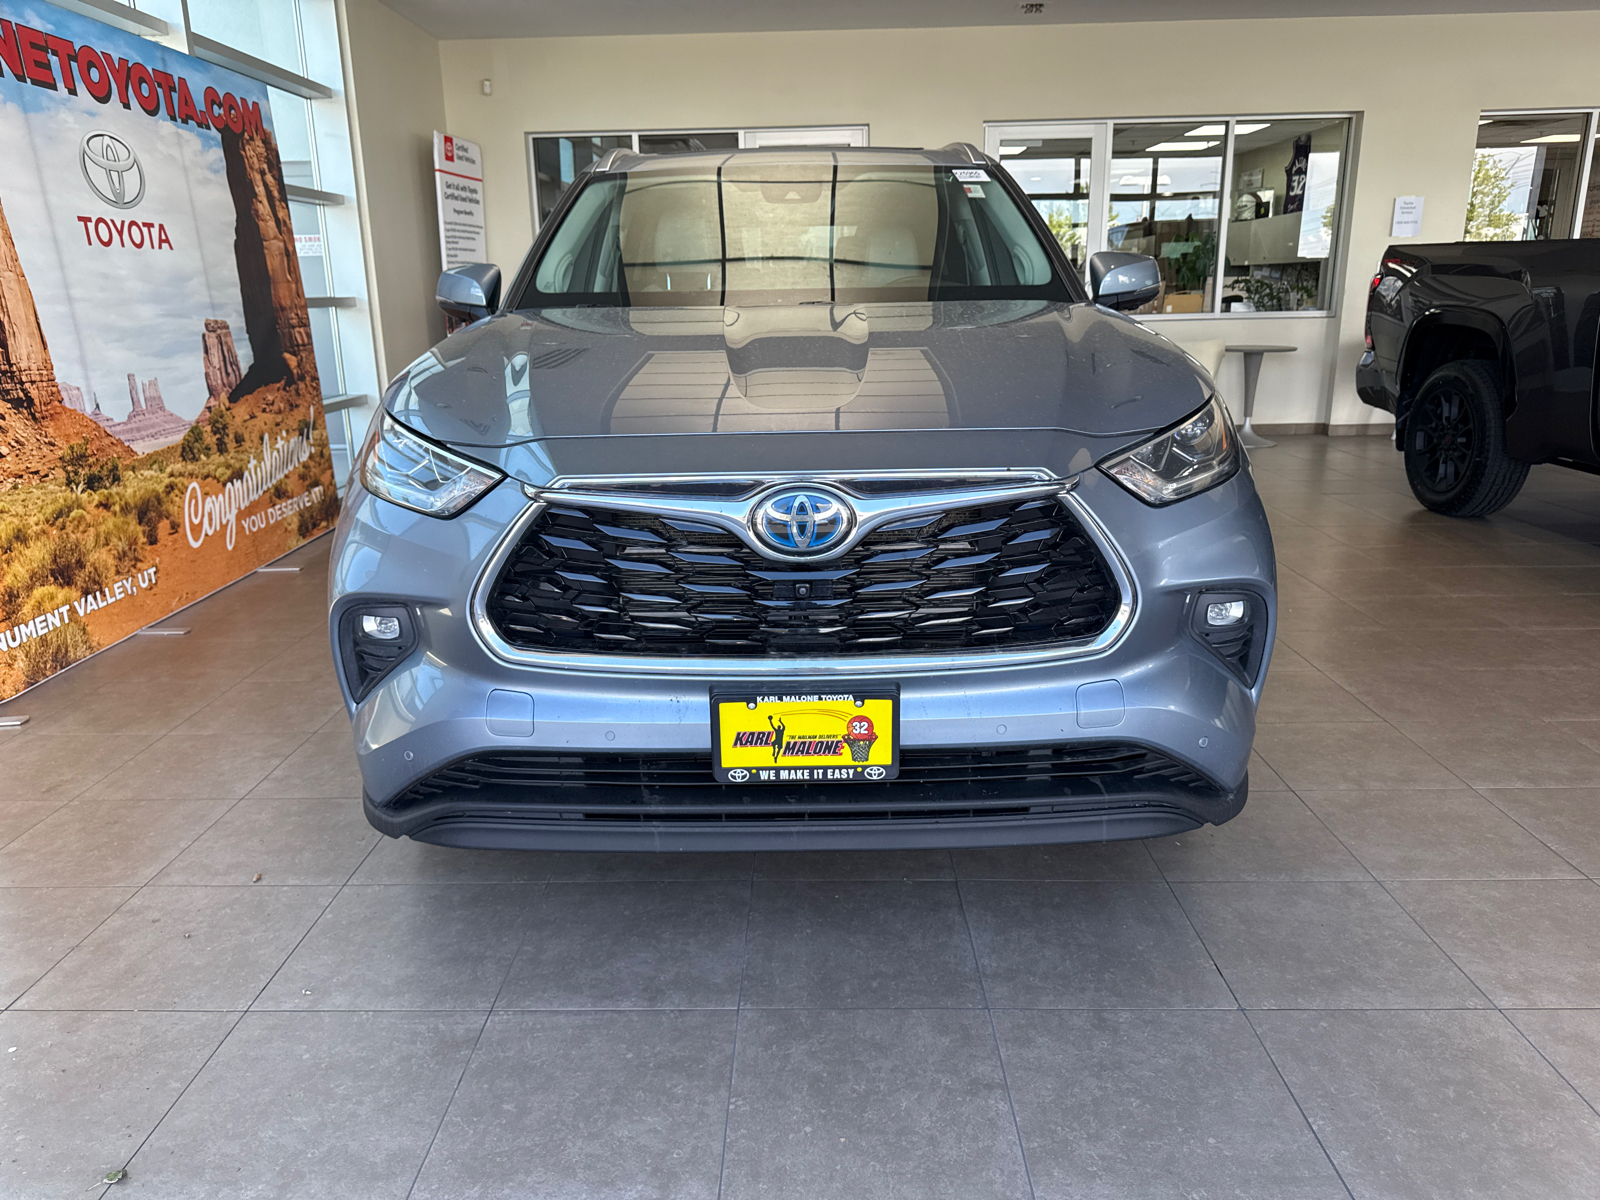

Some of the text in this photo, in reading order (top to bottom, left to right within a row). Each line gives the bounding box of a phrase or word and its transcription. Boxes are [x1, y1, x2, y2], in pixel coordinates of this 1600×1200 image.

[1289, 175, 1306, 196] 32
[76, 215, 174, 251] TOYOTA
[184, 404, 316, 551] Congratulations!
[241, 485, 325, 535] YOU DESERVE IT!
[73, 576, 137, 618] VALLEY,
[137, 566, 157, 589] UT
[756, 694, 855, 703] KARL MALONE TOYOTA
[852, 721, 869, 734] 32
[732, 731, 774, 748] KARL
[781, 739, 846, 757] MALONE
[759, 768, 855, 780] WE MAKE IT EASY
